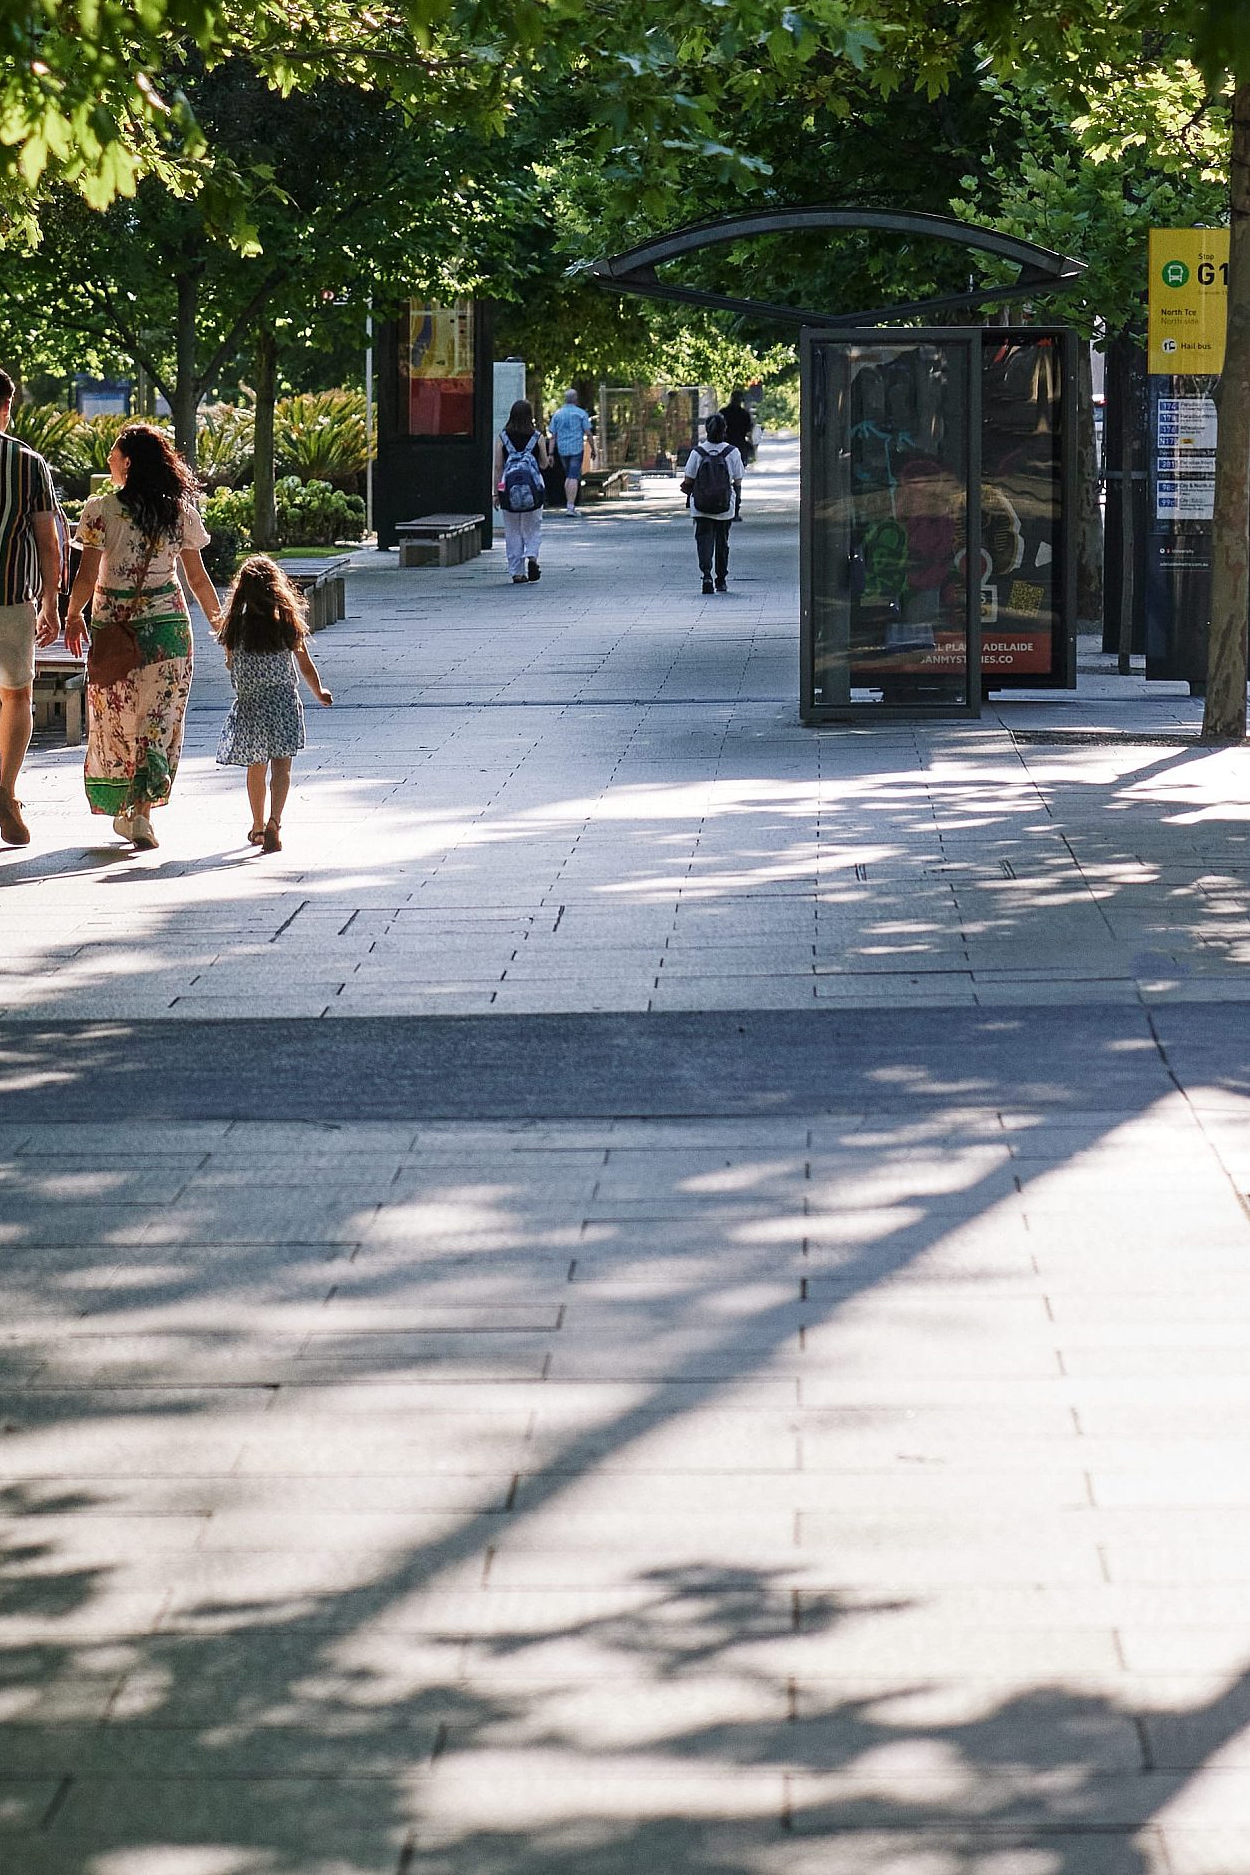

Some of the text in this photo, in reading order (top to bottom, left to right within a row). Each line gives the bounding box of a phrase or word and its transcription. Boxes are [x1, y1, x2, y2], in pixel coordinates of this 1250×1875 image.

[1198, 253, 1214, 261] Stop
[1198, 262, 1229, 286] G1
[1161, 308, 1197, 316] North Tce
[1161, 317, 1199, 325] North side
[1181, 342, 1212, 350] Hail bus
[1162, 402, 1177, 410] 174
[983, 643, 1034, 652] ADELAIDE
